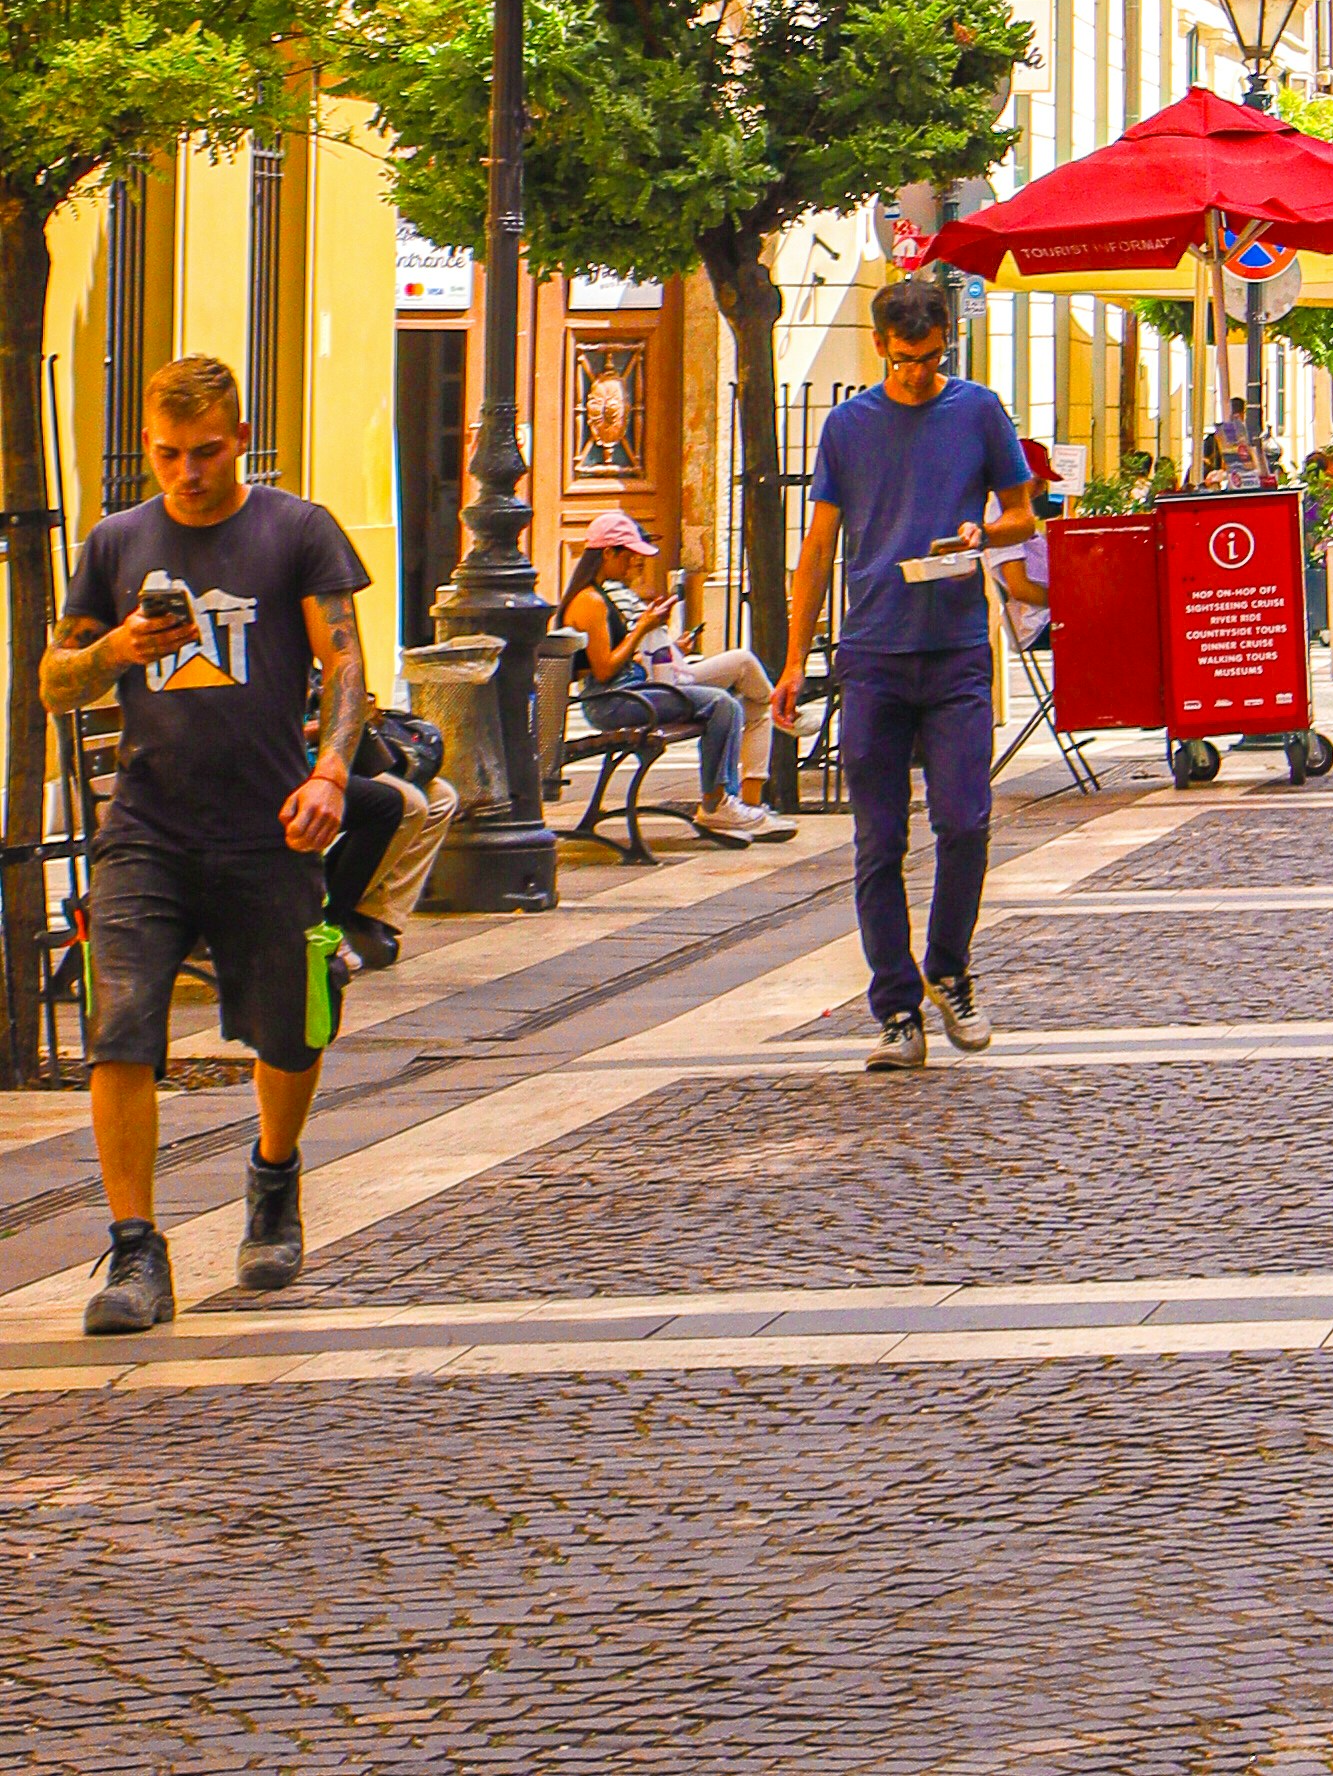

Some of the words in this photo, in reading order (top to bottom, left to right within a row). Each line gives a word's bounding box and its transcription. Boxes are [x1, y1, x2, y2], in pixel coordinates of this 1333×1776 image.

[1019, 243, 1089, 259] TOURIST
[1192, 589, 1214, 600] HOP
[1216, 586, 1257, 598] ON-HOP
[1259, 585, 1278, 595] OFF
[1185, 600, 1249, 614] SIGHTSEEING
[1251, 598, 1285, 609] CRUISE
[1210, 614, 1238, 625] RIVER
[1239, 612, 1262, 623] RIDE
[1185, 627, 1253, 640] COUNTRYSIDE
[1255, 624, 1288, 635] TOURS
[1200, 641, 1237, 652] DINNER
[1239, 638, 1274, 649] CRUISE
[1197, 654, 1243, 665] WALKING
[1245, 651, 1278, 661] TOURS
[1213, 665, 1264, 677] MUSEUMS
